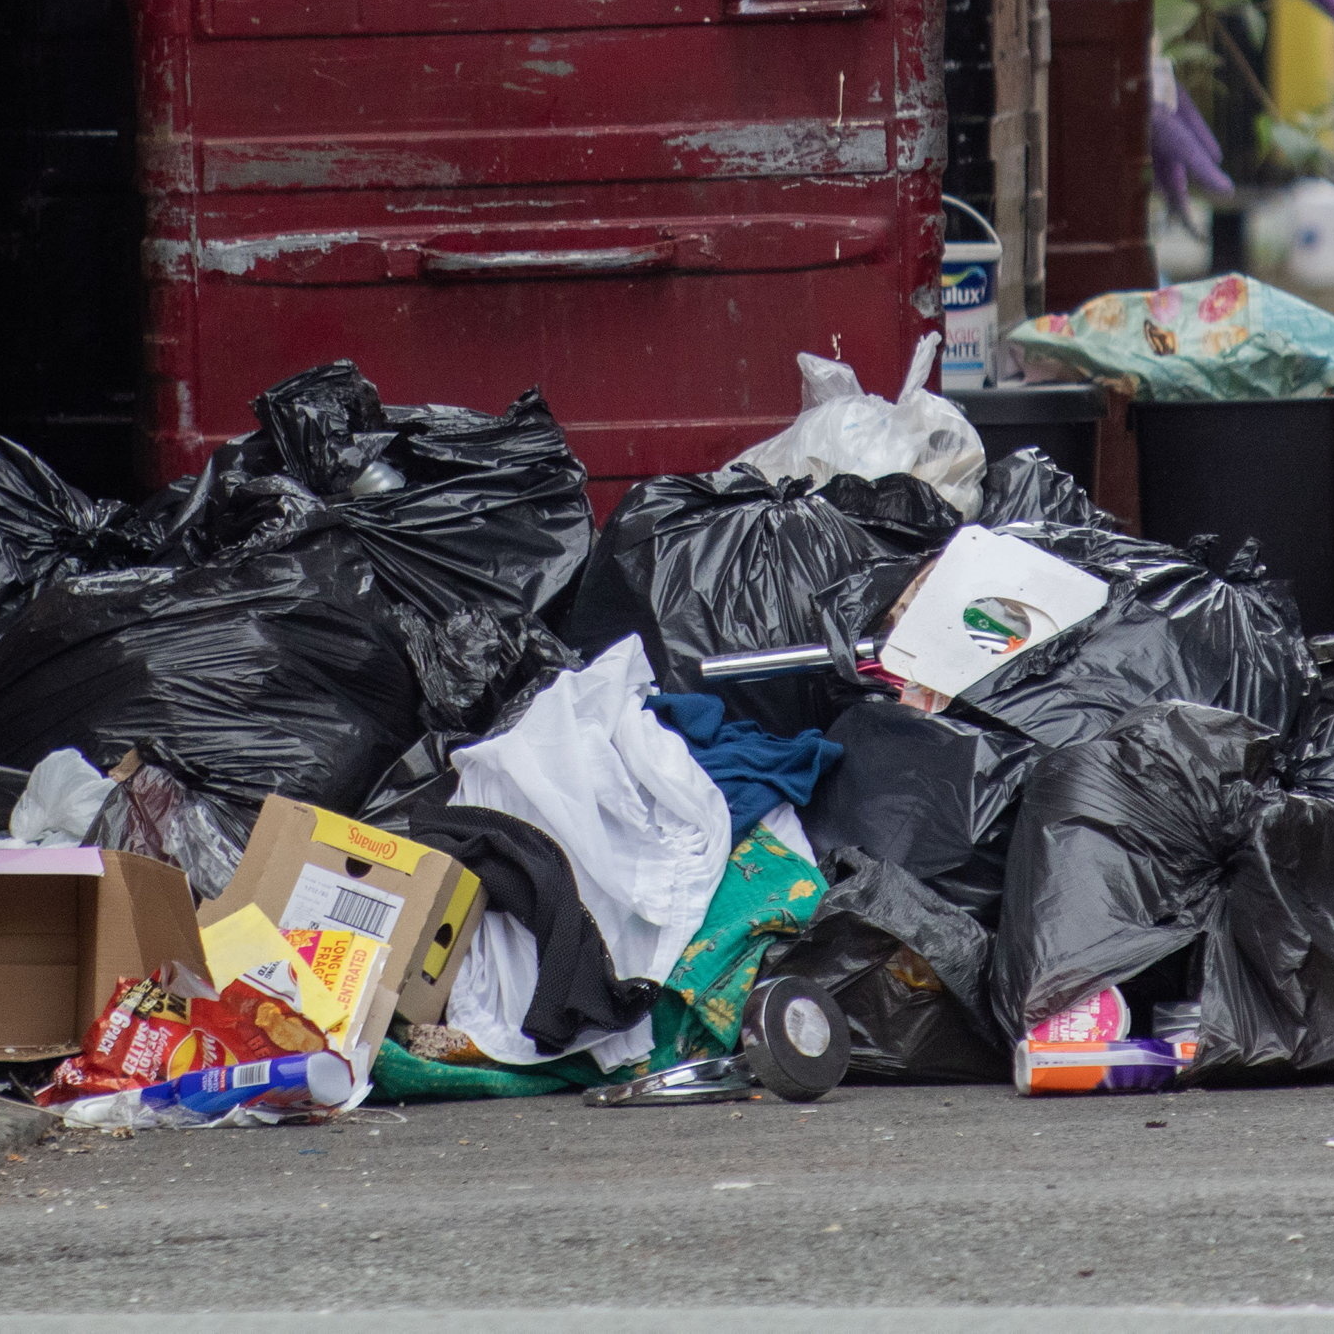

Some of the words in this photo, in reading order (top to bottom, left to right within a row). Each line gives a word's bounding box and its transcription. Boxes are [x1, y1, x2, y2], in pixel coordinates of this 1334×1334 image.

[941, 286, 982, 305] ulux
[944, 343, 980, 358] HITE
[946, 326, 981, 344] AGIC
[347, 826, 398, 860] Colman's
[313, 946, 332, 979] FRAG
[328, 939, 349, 971] LONG
[337, 949, 367, 1010] ENTRATED
[97, 1026, 123, 1056] PACK
[122, 1021, 148, 1076] SALTED
[135, 1028, 160, 1078] READY
